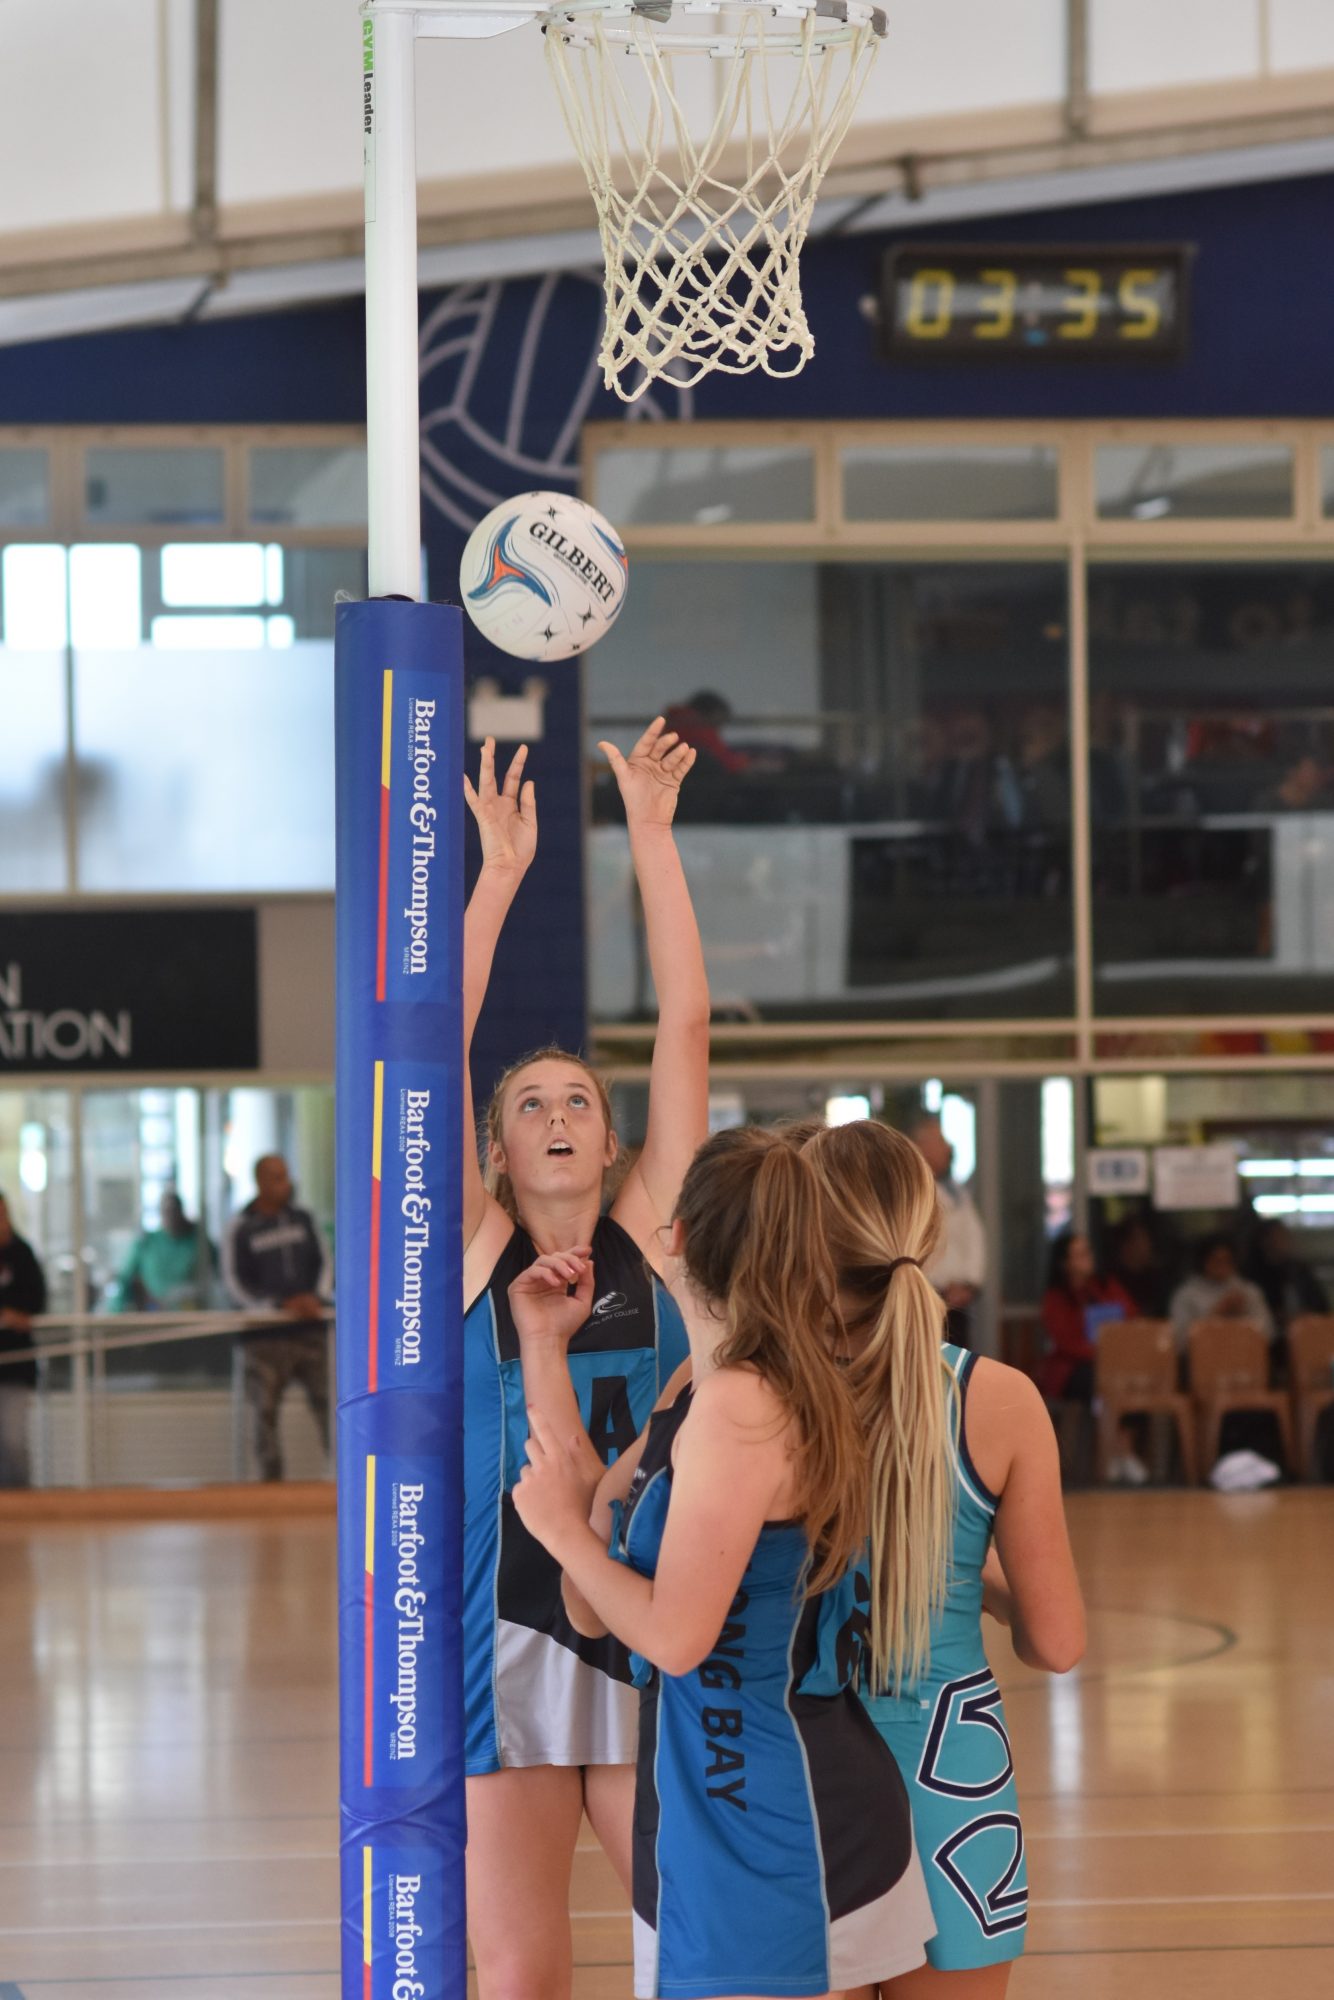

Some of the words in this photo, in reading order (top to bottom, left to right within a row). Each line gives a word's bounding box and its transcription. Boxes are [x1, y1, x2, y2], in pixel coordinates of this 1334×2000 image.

[528, 521, 616, 603] GILBERT
[413, 698, 437, 801] Barfoot
[403, 831, 436, 975] Thompson
[404, 1089, 431, 1192] Barfoot
[395, 1221, 430, 1366] Thompson
[398, 1483, 425, 1586] Barfoot
[697, 1559, 752, 1691] NG
[389, 1615, 425, 1760] Thompson
[701, 1706, 748, 1813] BAY
[395, 1874, 423, 1977] Barfoot
